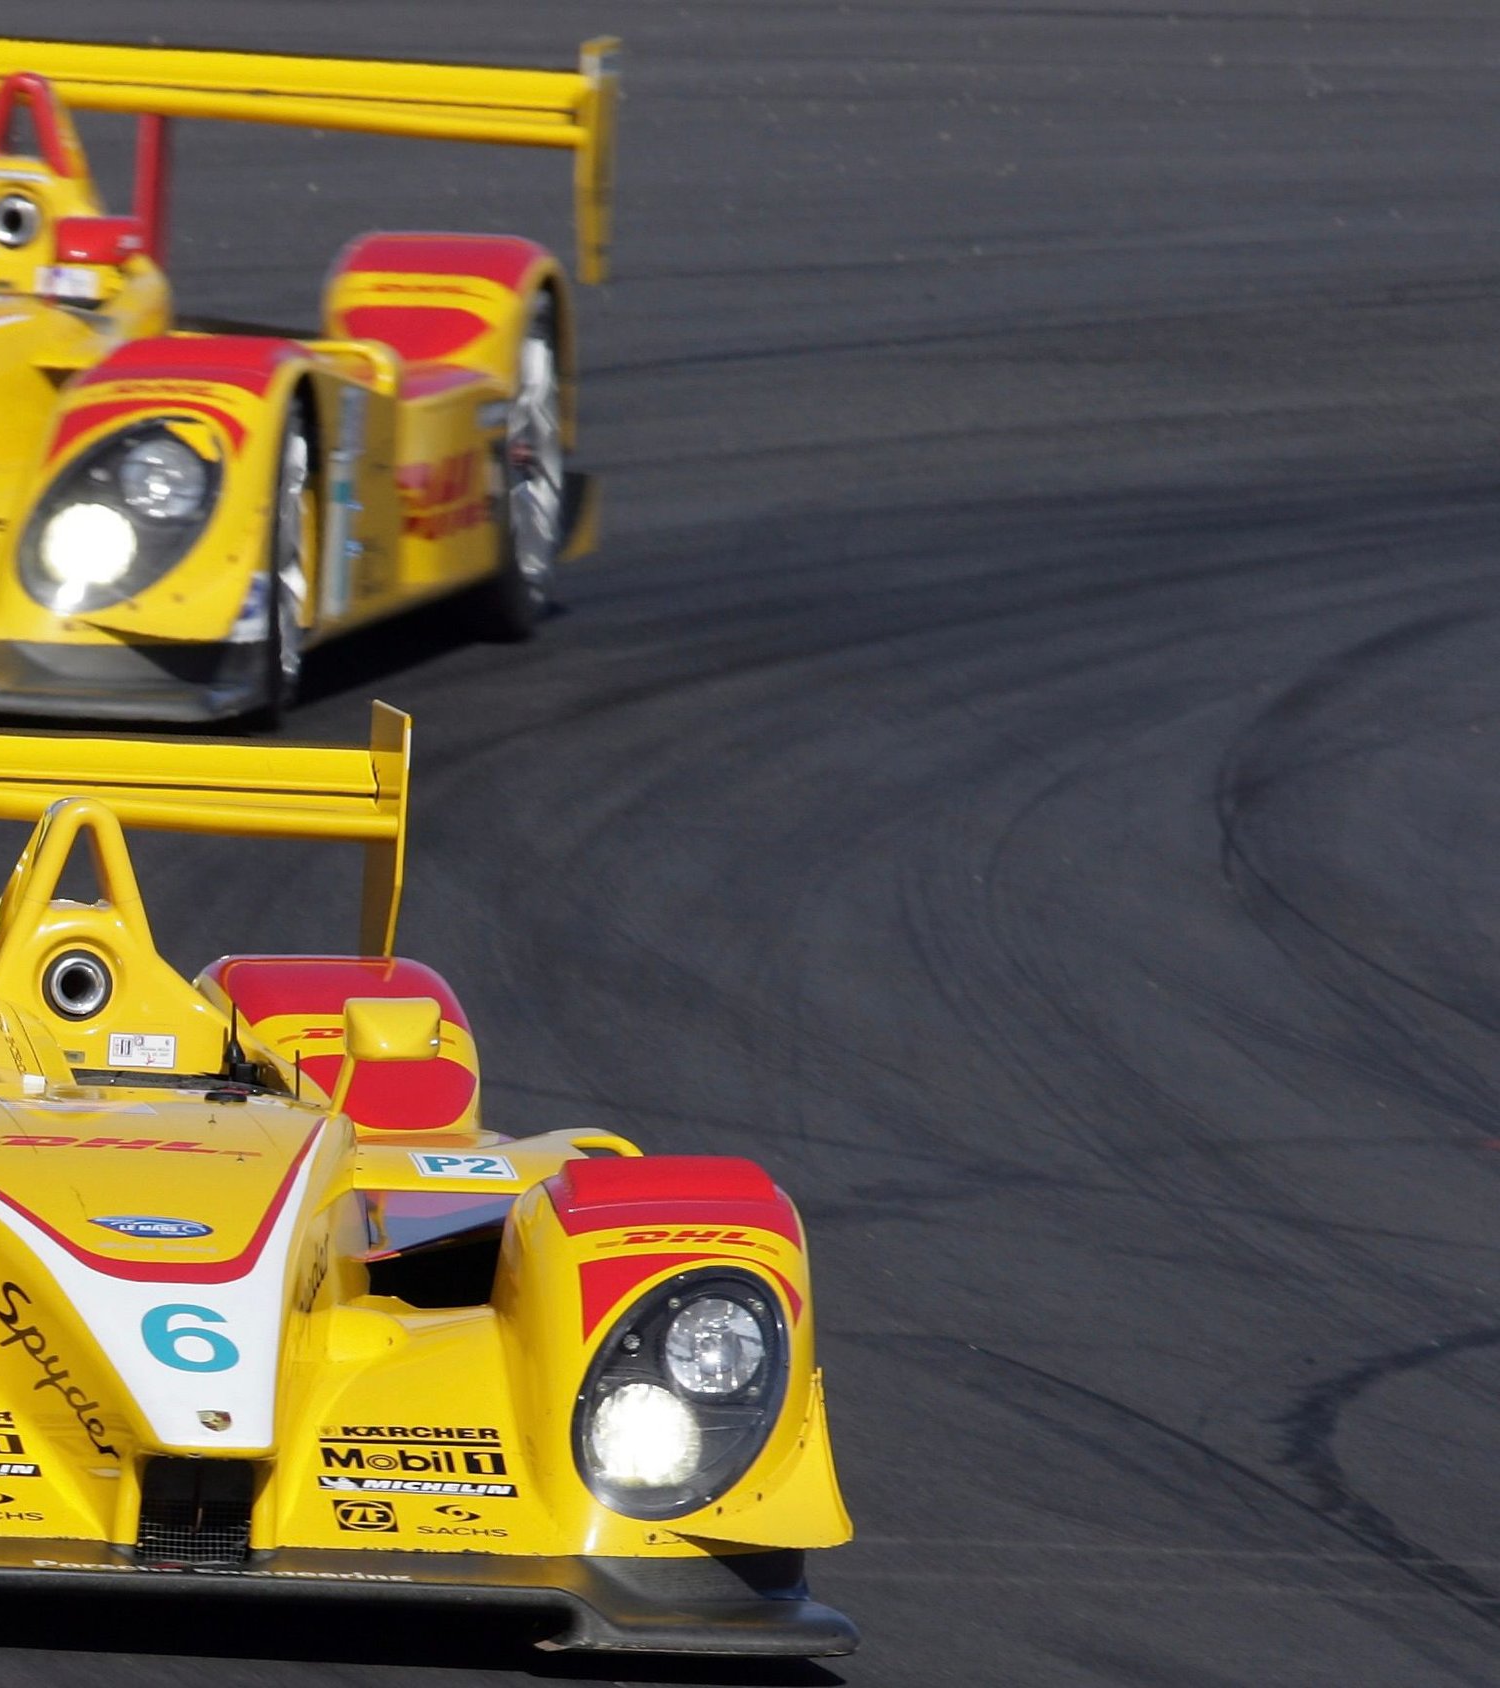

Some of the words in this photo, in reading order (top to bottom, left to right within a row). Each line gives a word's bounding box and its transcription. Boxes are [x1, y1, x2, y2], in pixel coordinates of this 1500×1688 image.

[0, 1135, 219, 1154] DHL
[422, 1156, 503, 1175] P2
[622, 1230, 756, 1247] DHL
[140, 1303, 240, 1373] 6
[321, 1447, 456, 1473] Mobil
[468, 1452, 500, 1475] 1
[362, 1479, 512, 1495] MICHELIN
[347, 1507, 386, 1524] ZF
[416, 1525, 509, 1538] SACHS
